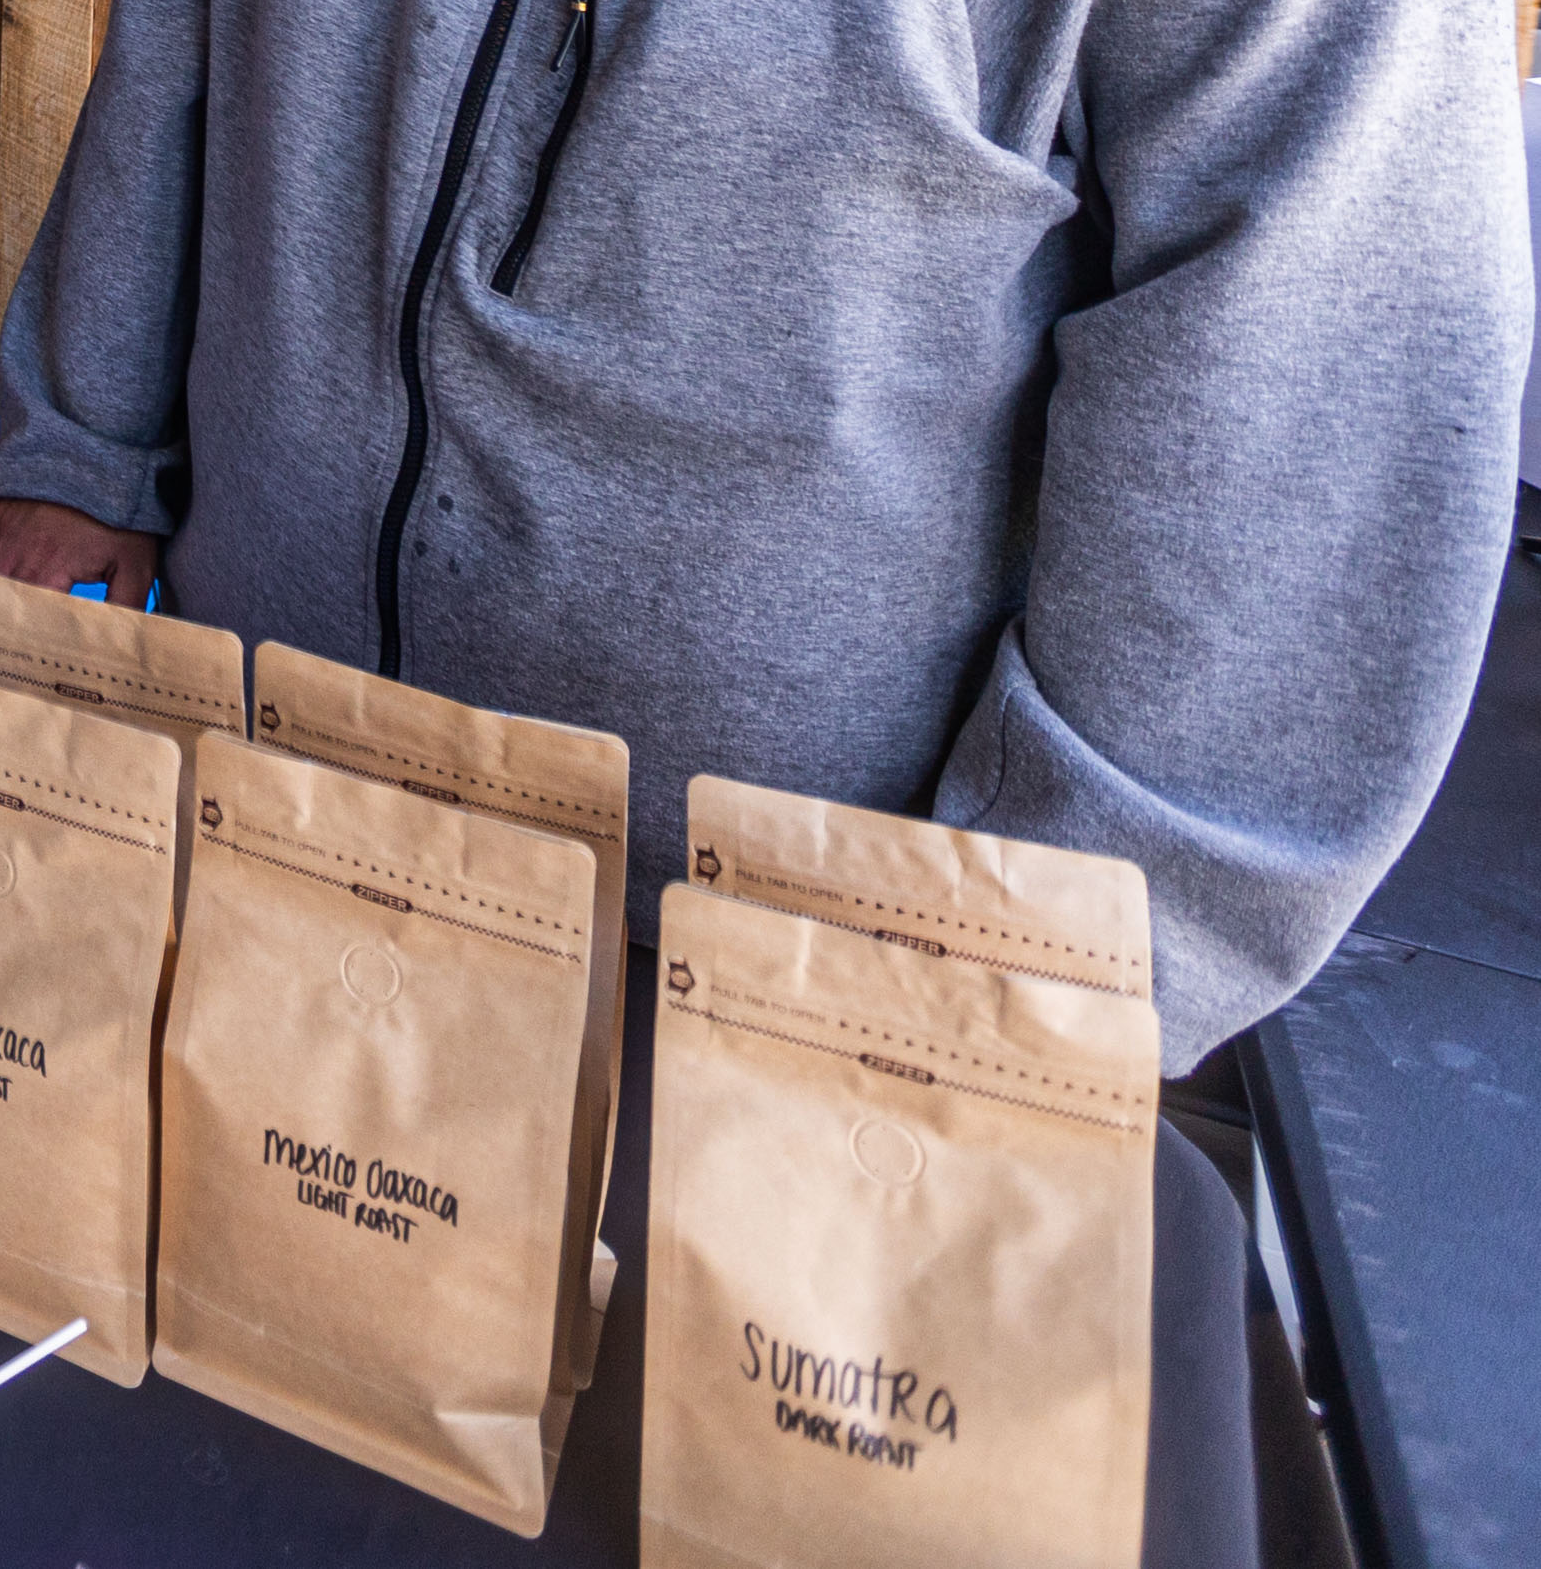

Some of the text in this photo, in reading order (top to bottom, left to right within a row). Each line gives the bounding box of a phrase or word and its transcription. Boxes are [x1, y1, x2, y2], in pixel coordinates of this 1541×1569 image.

[58, 685, 99, 704] ZIPPER
[408, 782, 455, 802] ZIPPER
[281, 836, 295, 848] TO
[357, 886, 408, 912] ZIPPER
[735, 868, 843, 904] PULL TAB TO OPEN
[882, 932, 940, 956] ZIPPER
[867, 1056, 928, 1083] ZIPPER
[366, 1159, 459, 1228] Oaxaca
[297, 1179, 419, 1244] LIGHT ROAST
[775, 1399, 924, 1472] DARK ROAST
